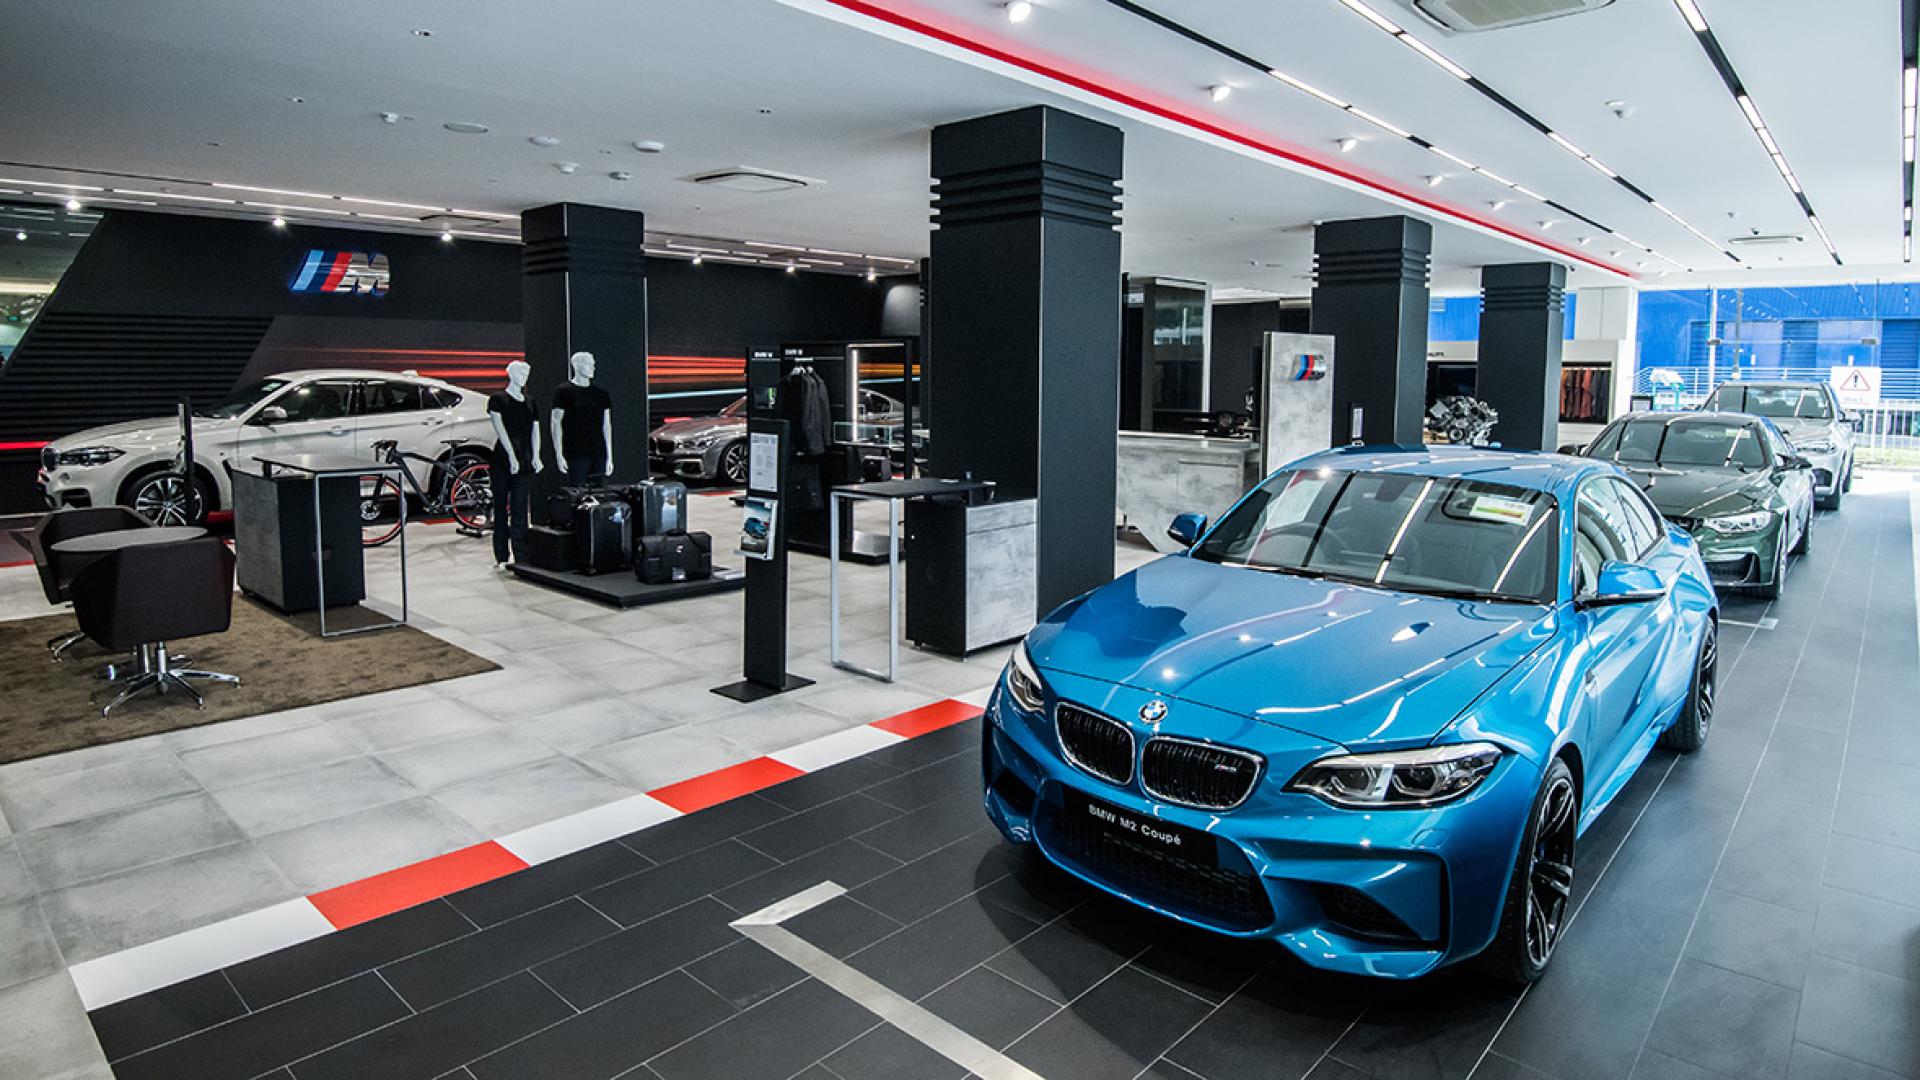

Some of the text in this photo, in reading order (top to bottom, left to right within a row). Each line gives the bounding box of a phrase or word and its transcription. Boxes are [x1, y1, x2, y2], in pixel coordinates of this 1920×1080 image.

[1088, 804, 1182, 846] BMW M2 Coupé
